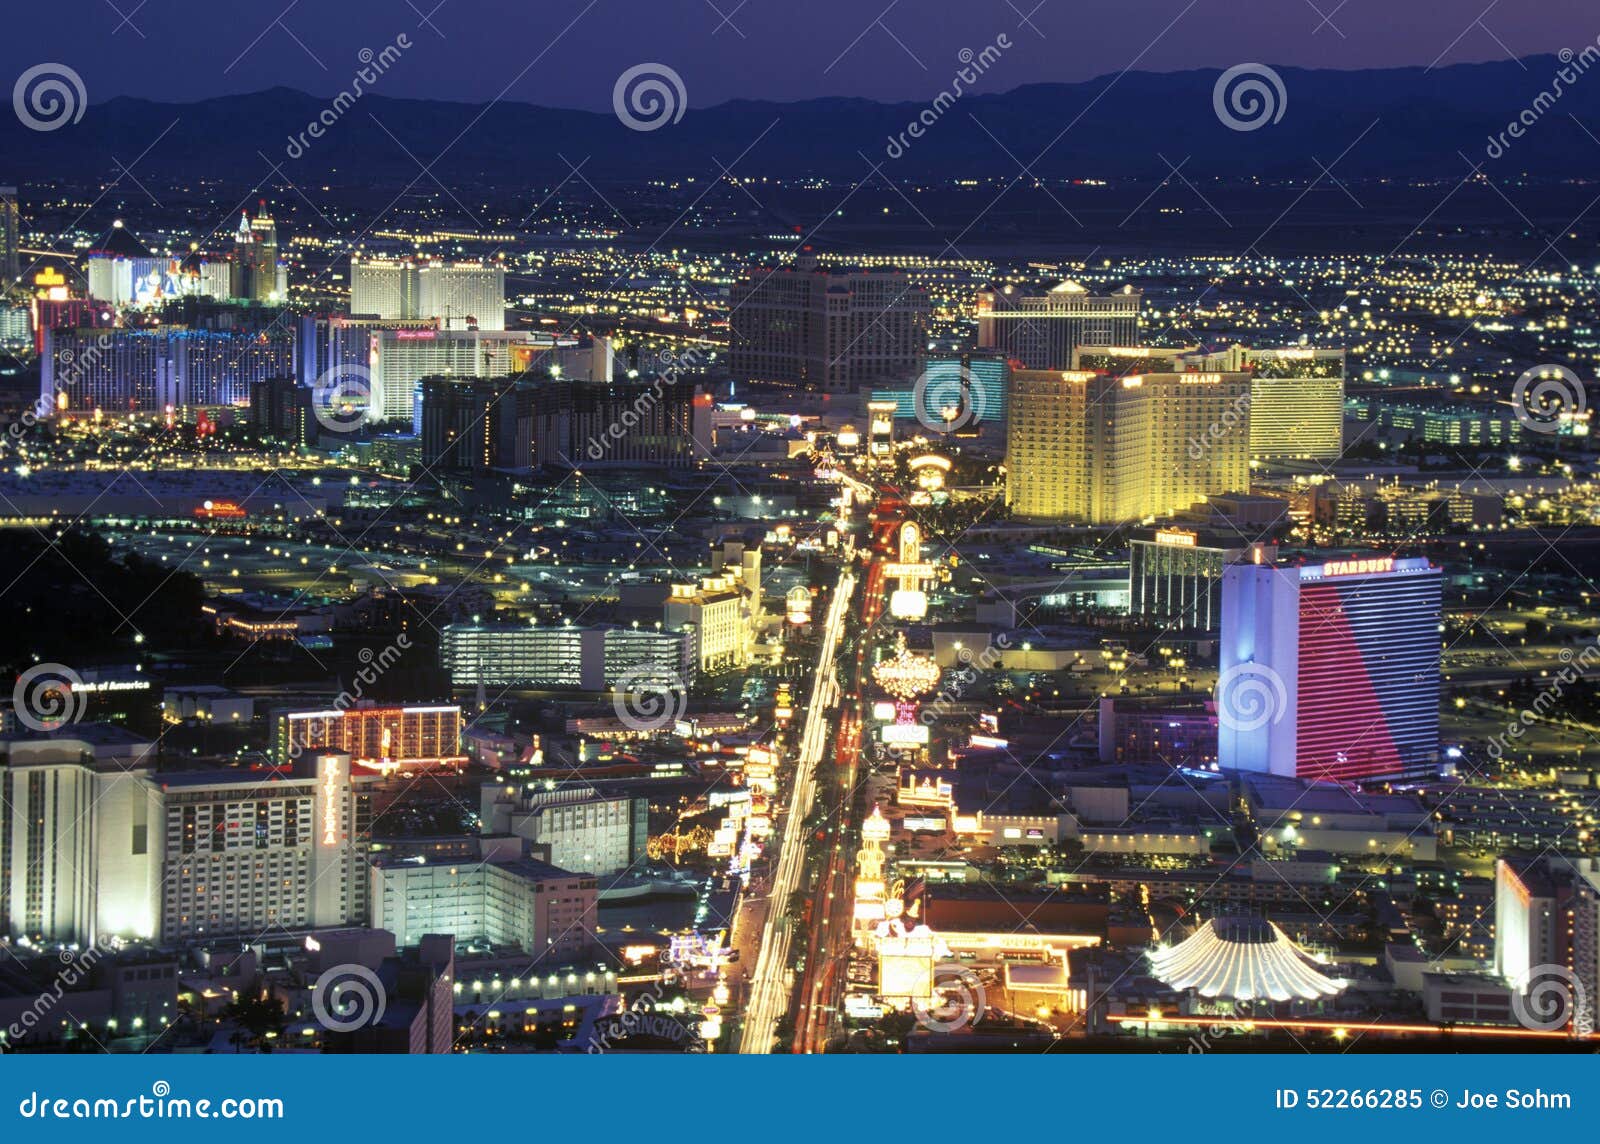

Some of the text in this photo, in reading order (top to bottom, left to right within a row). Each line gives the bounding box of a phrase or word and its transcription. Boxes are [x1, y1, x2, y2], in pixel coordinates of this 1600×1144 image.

[1323, 558, 1393, 576] STARDUST
[72, 680, 150, 692] Bank of America
[896, 702, 916, 711] Enter
